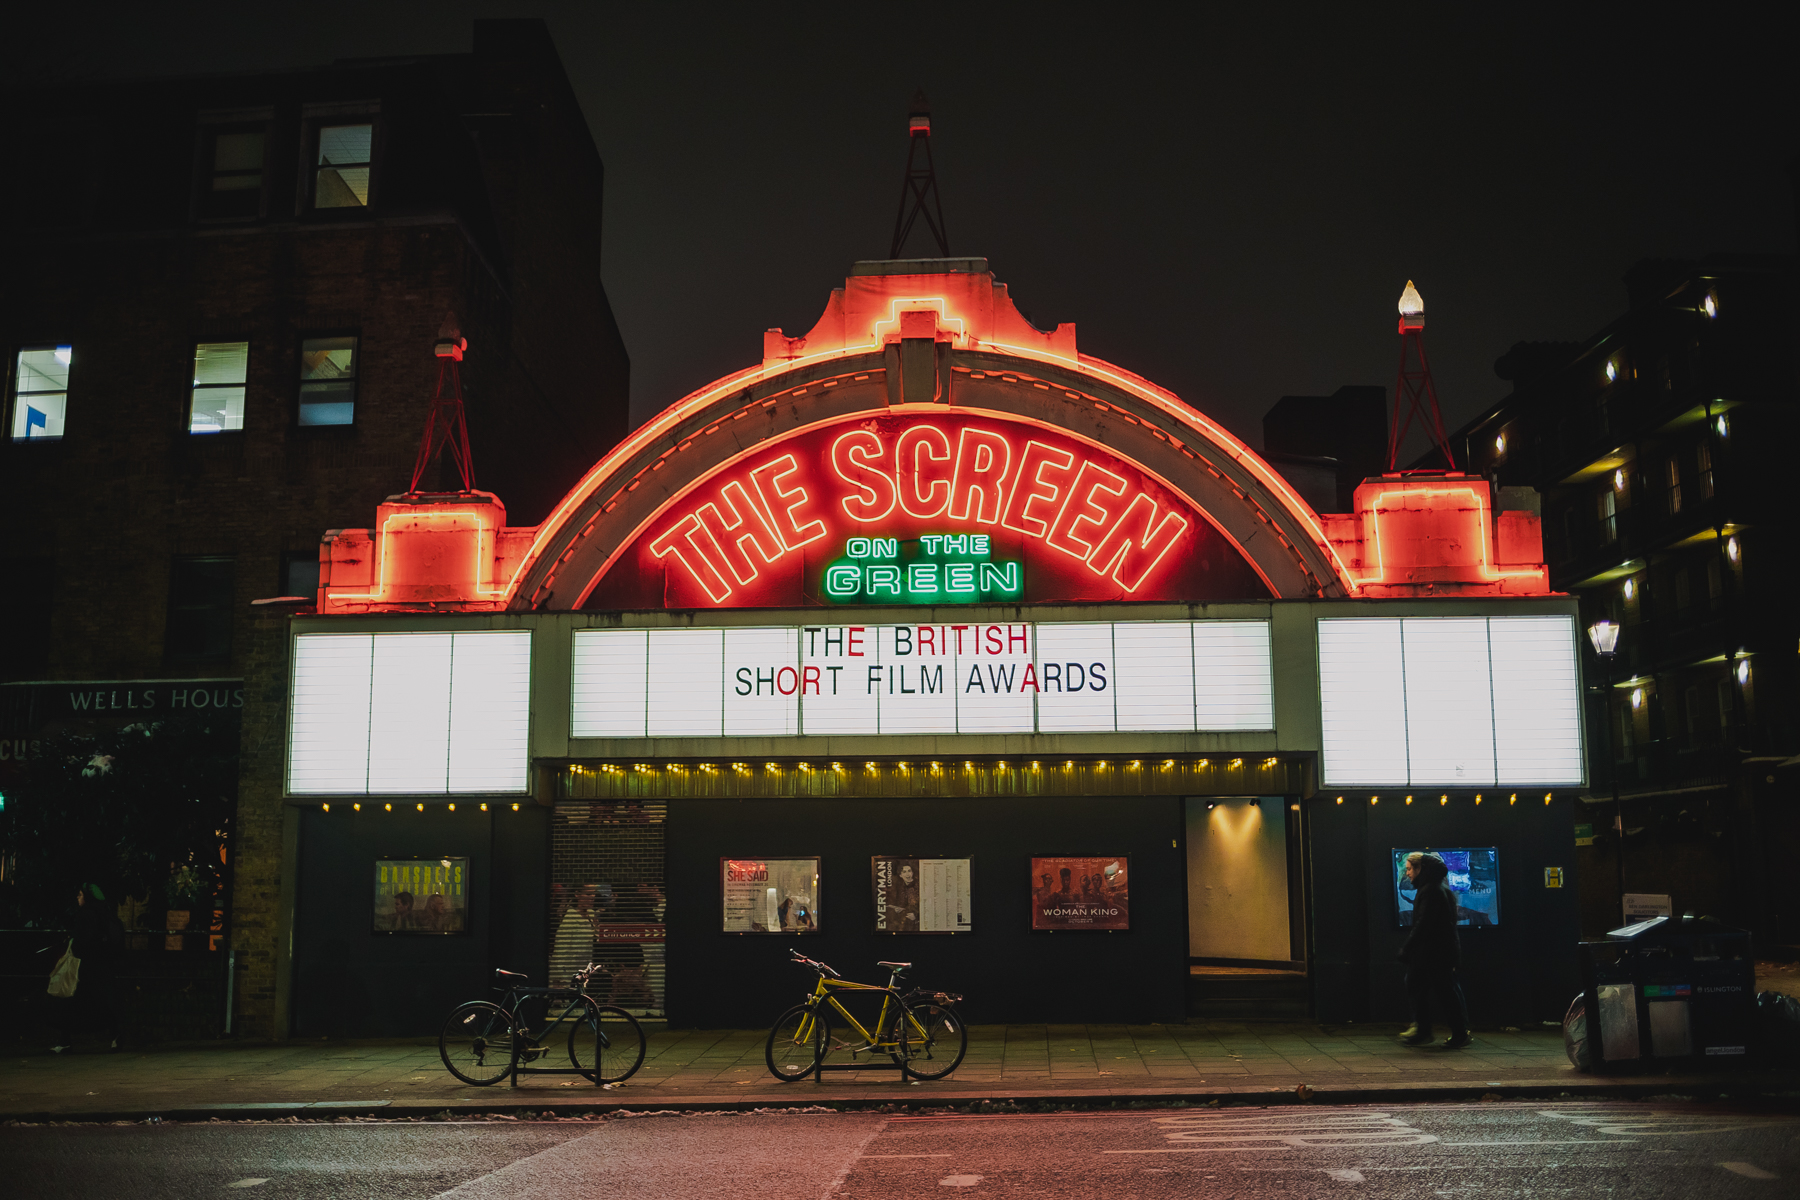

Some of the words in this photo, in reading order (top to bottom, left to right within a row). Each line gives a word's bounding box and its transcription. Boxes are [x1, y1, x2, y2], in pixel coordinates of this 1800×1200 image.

[649, 453, 827, 603] THE
[832, 425, 1188, 593] SCREEN
[846, 537, 898, 558] ON
[920, 534, 990, 555] THE
[826, 562, 1018, 596] GREEN
[804, 627, 865, 657] THE
[894, 624, 1029, 656] BRITISH
[734, 665, 844, 696] SHORT
[867, 664, 944, 695] FILM
[965, 662, 1108, 694] AWARDS
[70, 690, 156, 711] WELLS
[381, 866, 462, 883] BANSHEES
[727, 870, 745, 882] SHE
[747, 870, 769, 882] SAID
[877, 861, 887, 929] EVERYMAN
[1043, 908, 1087, 916] WOMAN
[1090, 908, 1119, 916] KING
